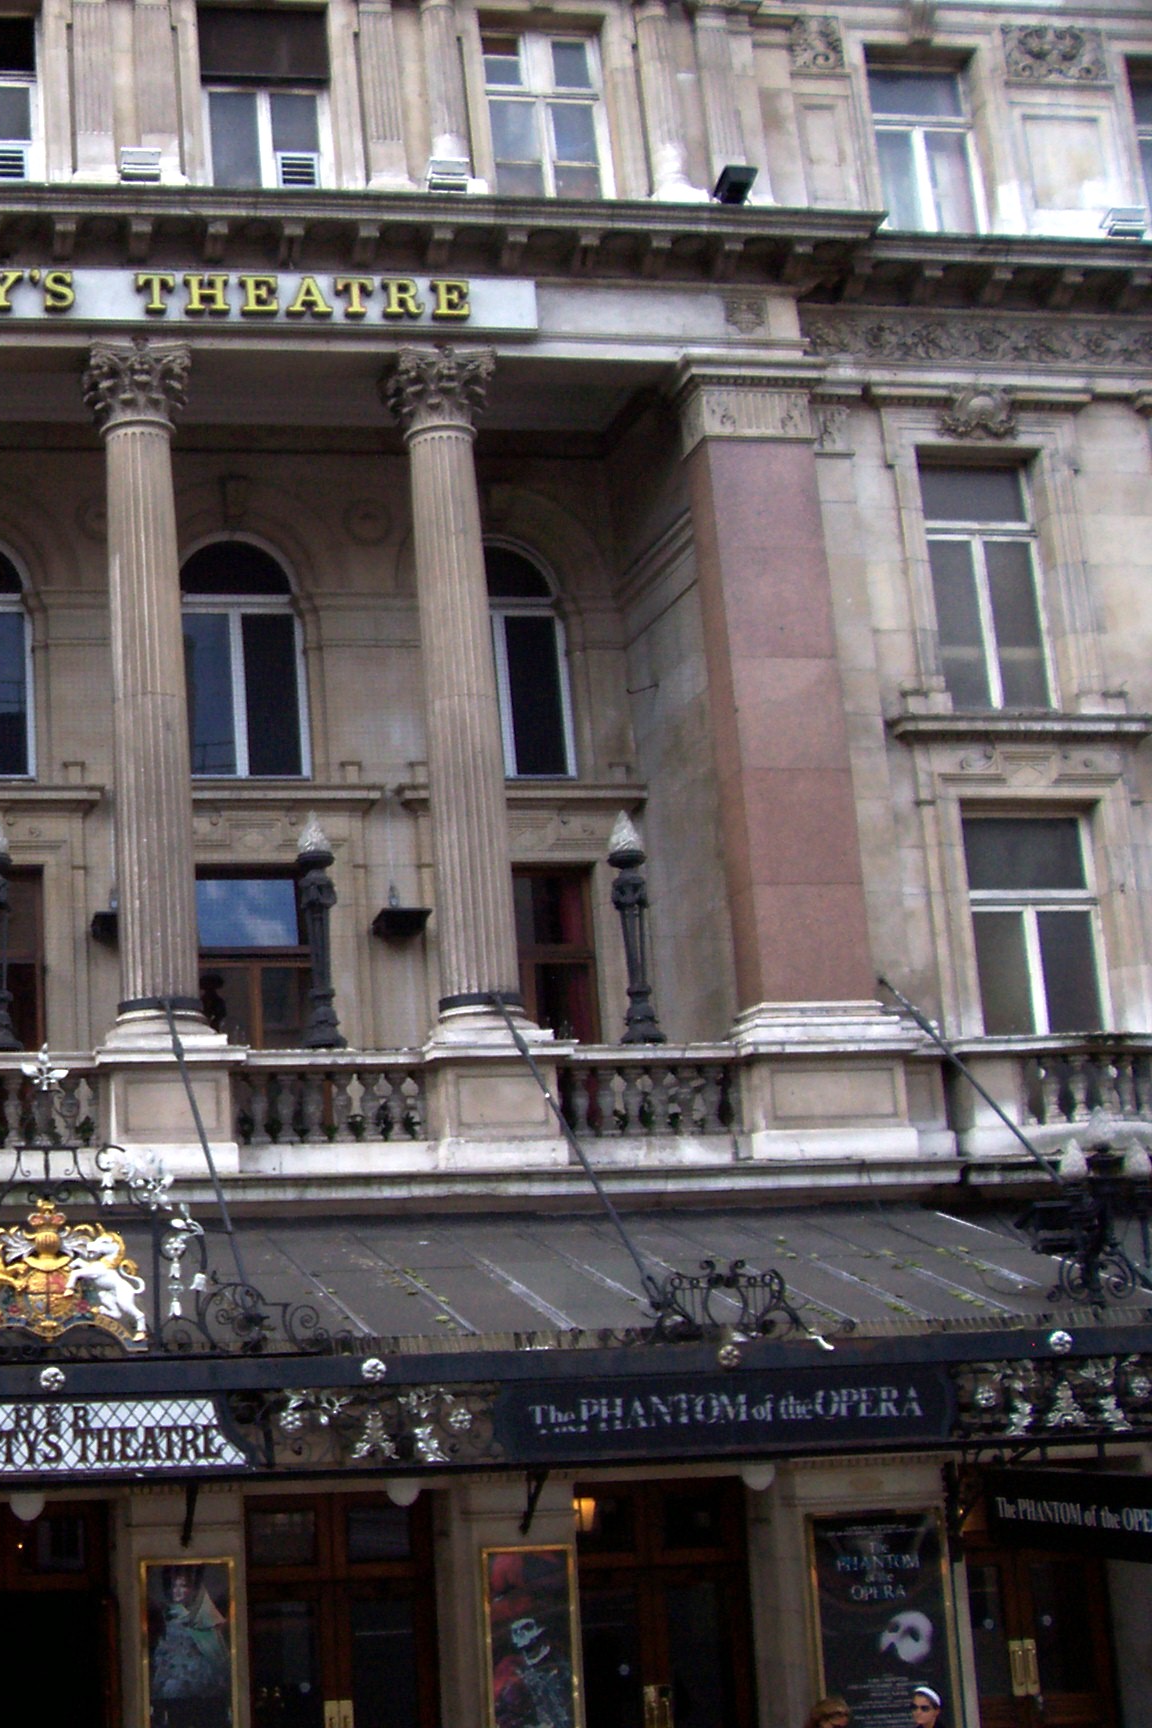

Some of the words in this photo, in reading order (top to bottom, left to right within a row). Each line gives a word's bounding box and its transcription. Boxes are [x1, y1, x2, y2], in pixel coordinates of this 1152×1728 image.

[134, 272, 472, 320] THEATRE
[14, 1405, 90, 1430] HER
[528, 1404, 578, 1434] The
[580, 1392, 748, 1432] PHANTOM
[751, 1394, 775, 1423] of
[779, 1391, 813, 1420] the
[813, 1386, 924, 1420] OPERA
[73, 1423, 223, 1463] THEATRE
[1017, 1498, 1083, 1526] PHANTOM
